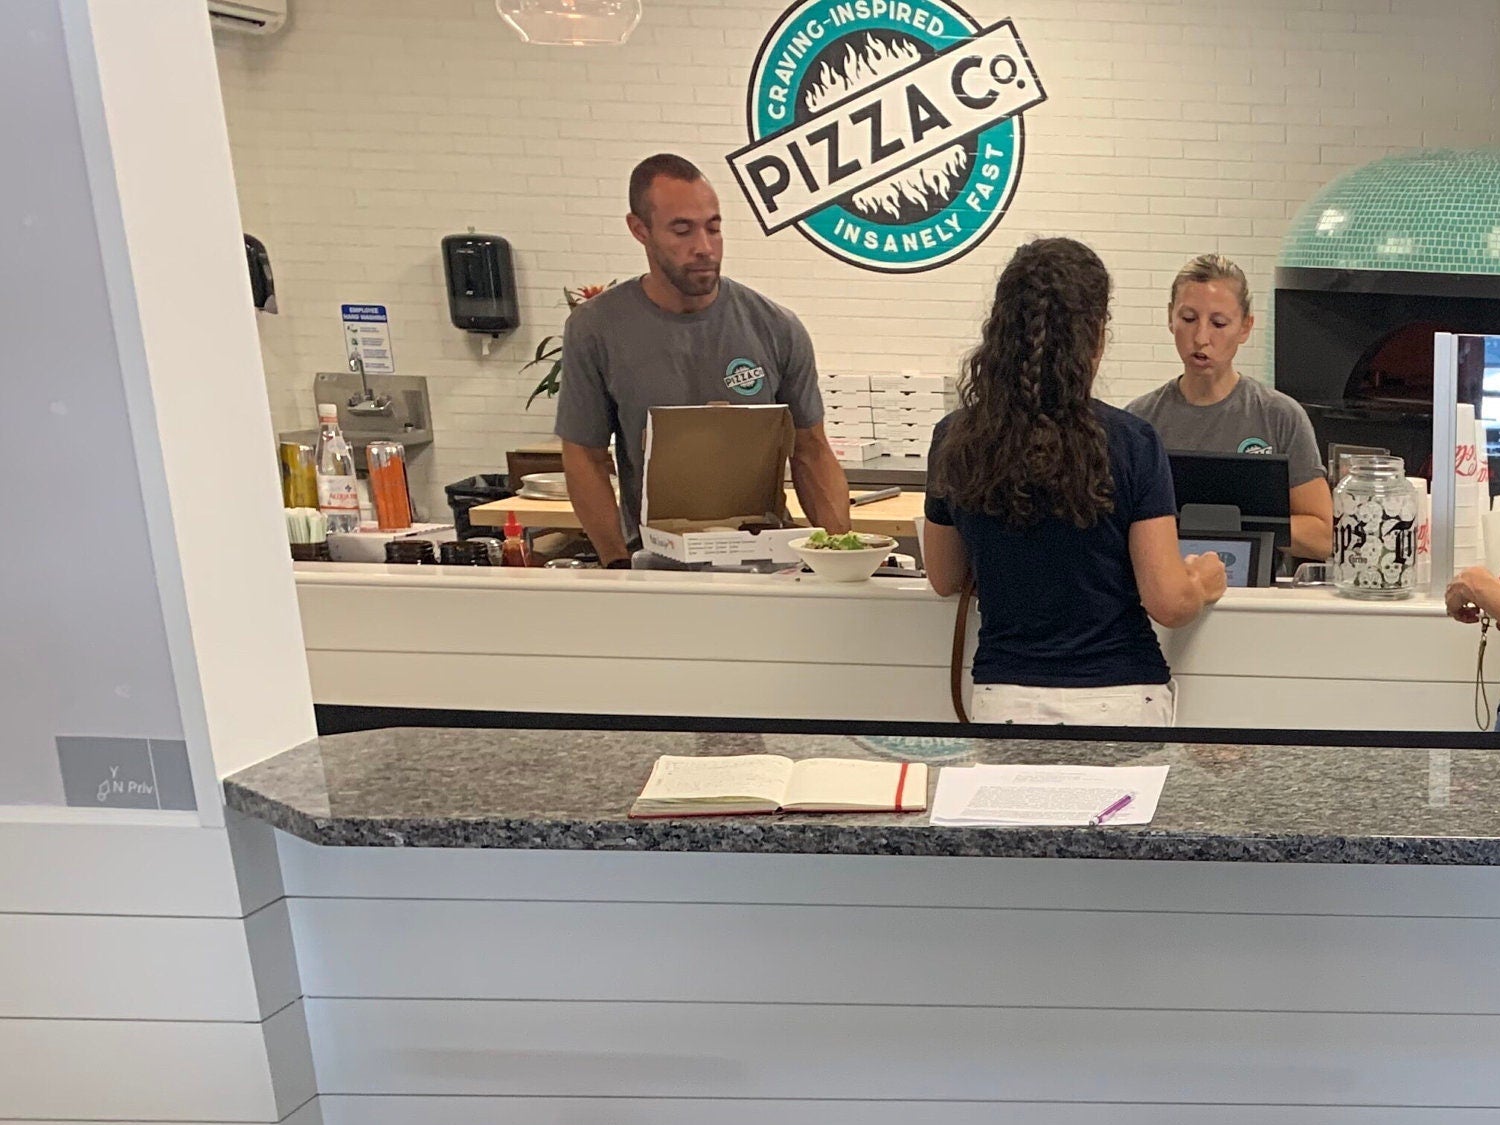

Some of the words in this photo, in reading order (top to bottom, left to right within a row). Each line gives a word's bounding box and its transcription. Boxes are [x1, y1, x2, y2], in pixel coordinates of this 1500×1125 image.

[745, 83, 952, 214] PIZZA
[833, 212, 962, 253] INSANELY
[966, 143, 1004, 212] FAST
[726, 371, 754, 387] PIZZA
